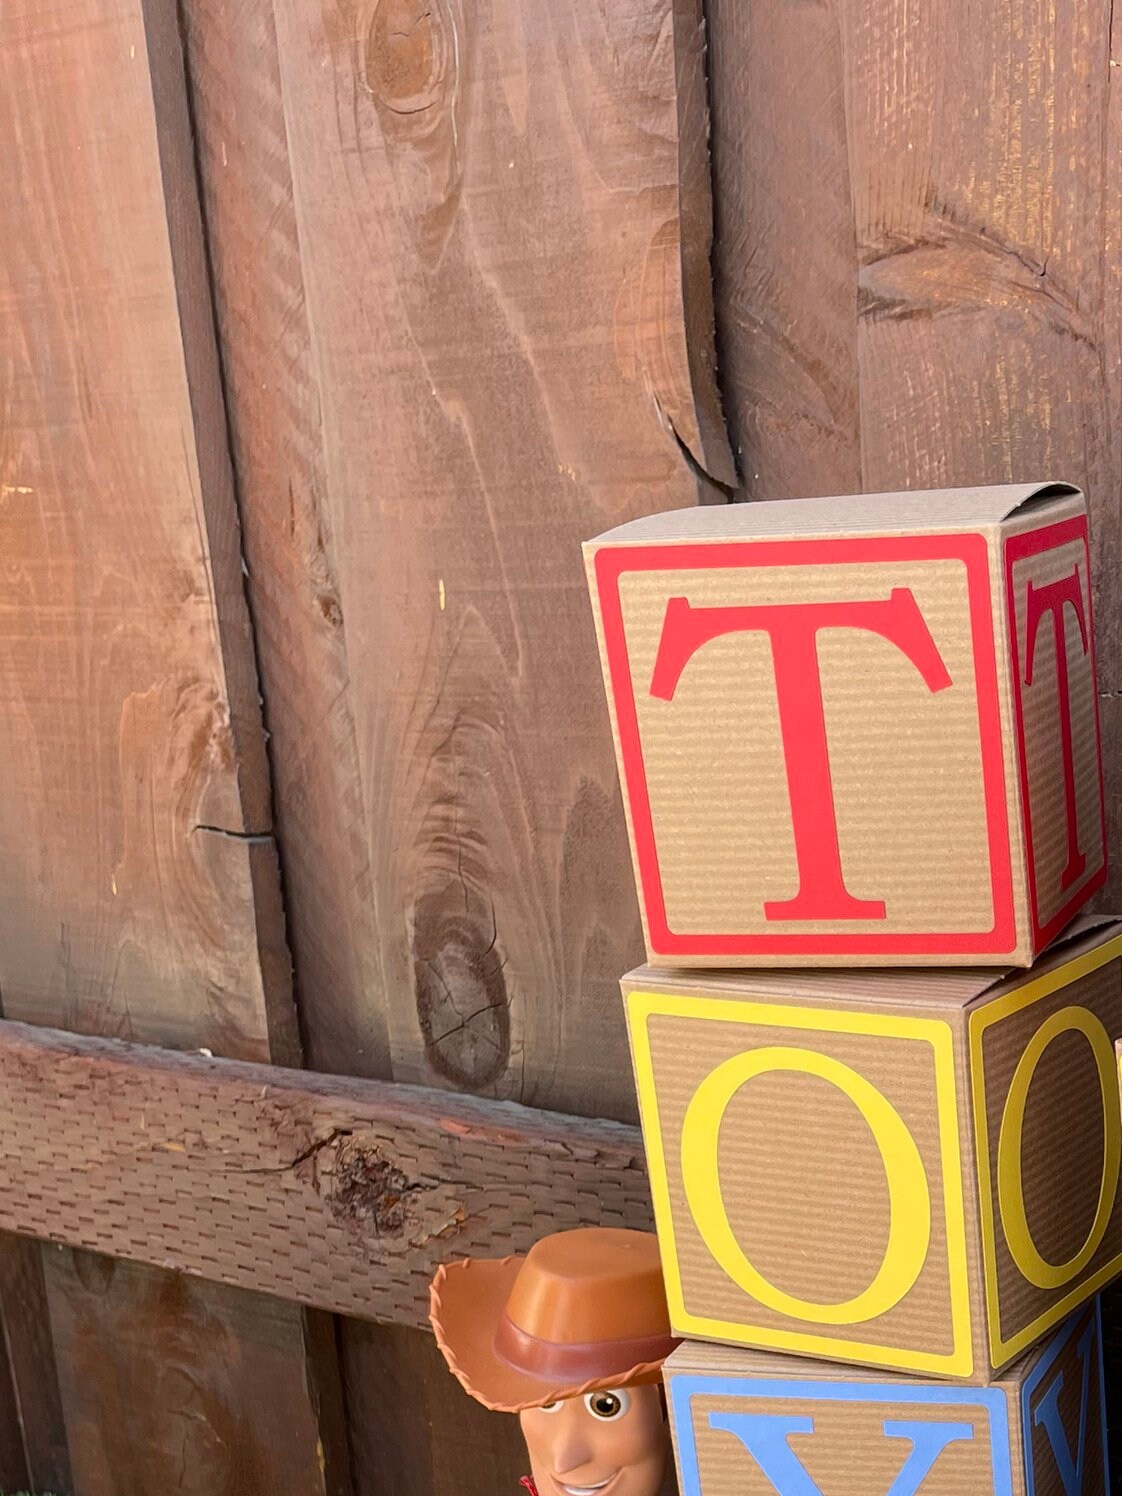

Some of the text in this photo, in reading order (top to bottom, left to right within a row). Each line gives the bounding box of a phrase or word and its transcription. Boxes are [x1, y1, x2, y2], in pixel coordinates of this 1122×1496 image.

[649, 587, 953, 921] T
[1024, 563, 1088, 891] T
[680, 1046, 931, 1325] O
[997, 1005, 1122, 1290] O
